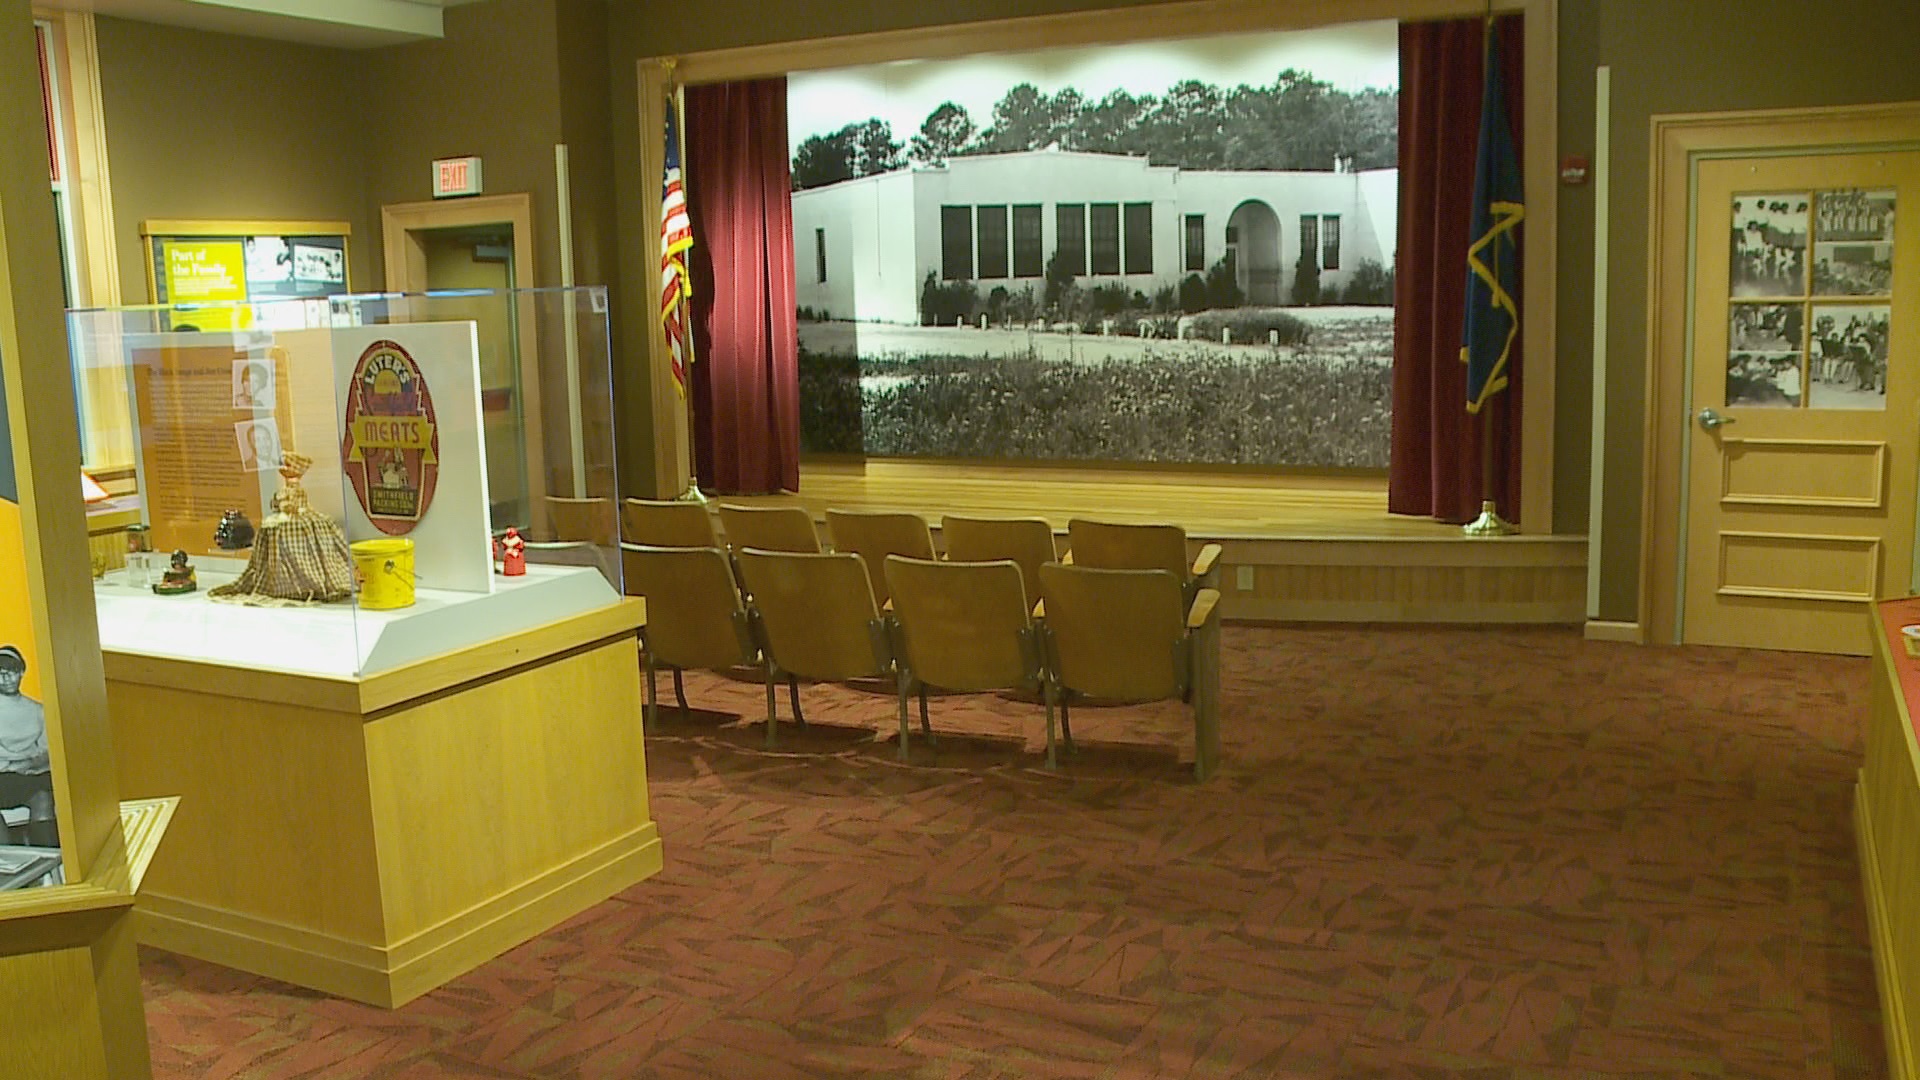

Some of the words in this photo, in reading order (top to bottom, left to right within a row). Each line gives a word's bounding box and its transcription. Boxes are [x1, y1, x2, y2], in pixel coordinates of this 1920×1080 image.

[440, 162, 467, 191] EXIT
[171, 248, 194, 261] Part
[196, 247, 207, 261] of
[173, 264, 190, 276] the
[192, 263, 226, 280] Family
[364, 355, 411, 385] LUTER'S
[364, 421, 420, 443] MEATS
[373, 490, 414, 501] SMITHFIELD
